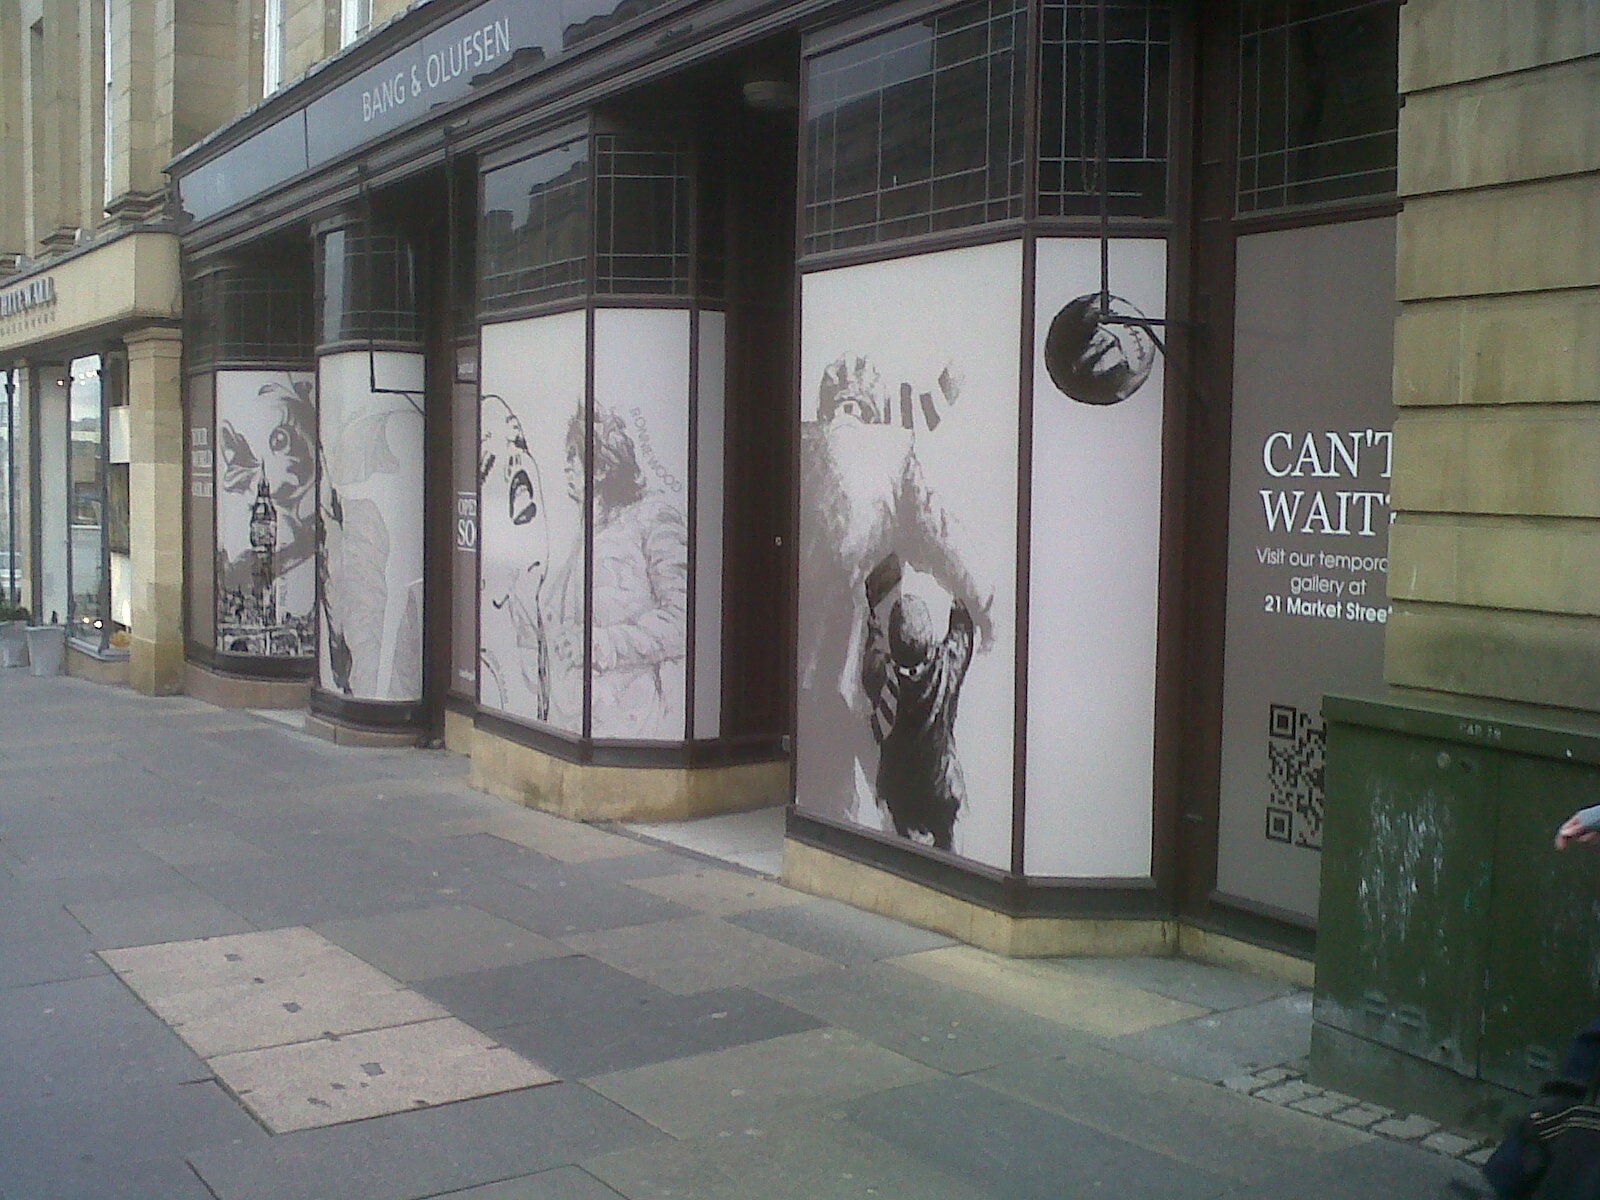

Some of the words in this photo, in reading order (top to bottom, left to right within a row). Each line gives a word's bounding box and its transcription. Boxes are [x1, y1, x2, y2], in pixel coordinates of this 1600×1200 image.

[362, 72, 405, 122] BANG
[410, 64, 422, 97] &
[426, 18, 510, 88] OLUFSEN
[1263, 429, 1392, 477] CAN'T
[457, 518, 477, 547] SO
[1256, 546, 1286, 564] Visit
[1289, 551, 1315, 567] our
[1319, 550, 1389, 573] tempora
[1290, 574, 1344, 597] gallery
[1348, 579, 1367, 596] at
[1265, 595, 1282, 613] 21
[1286, 596, 1342, 619] Market
